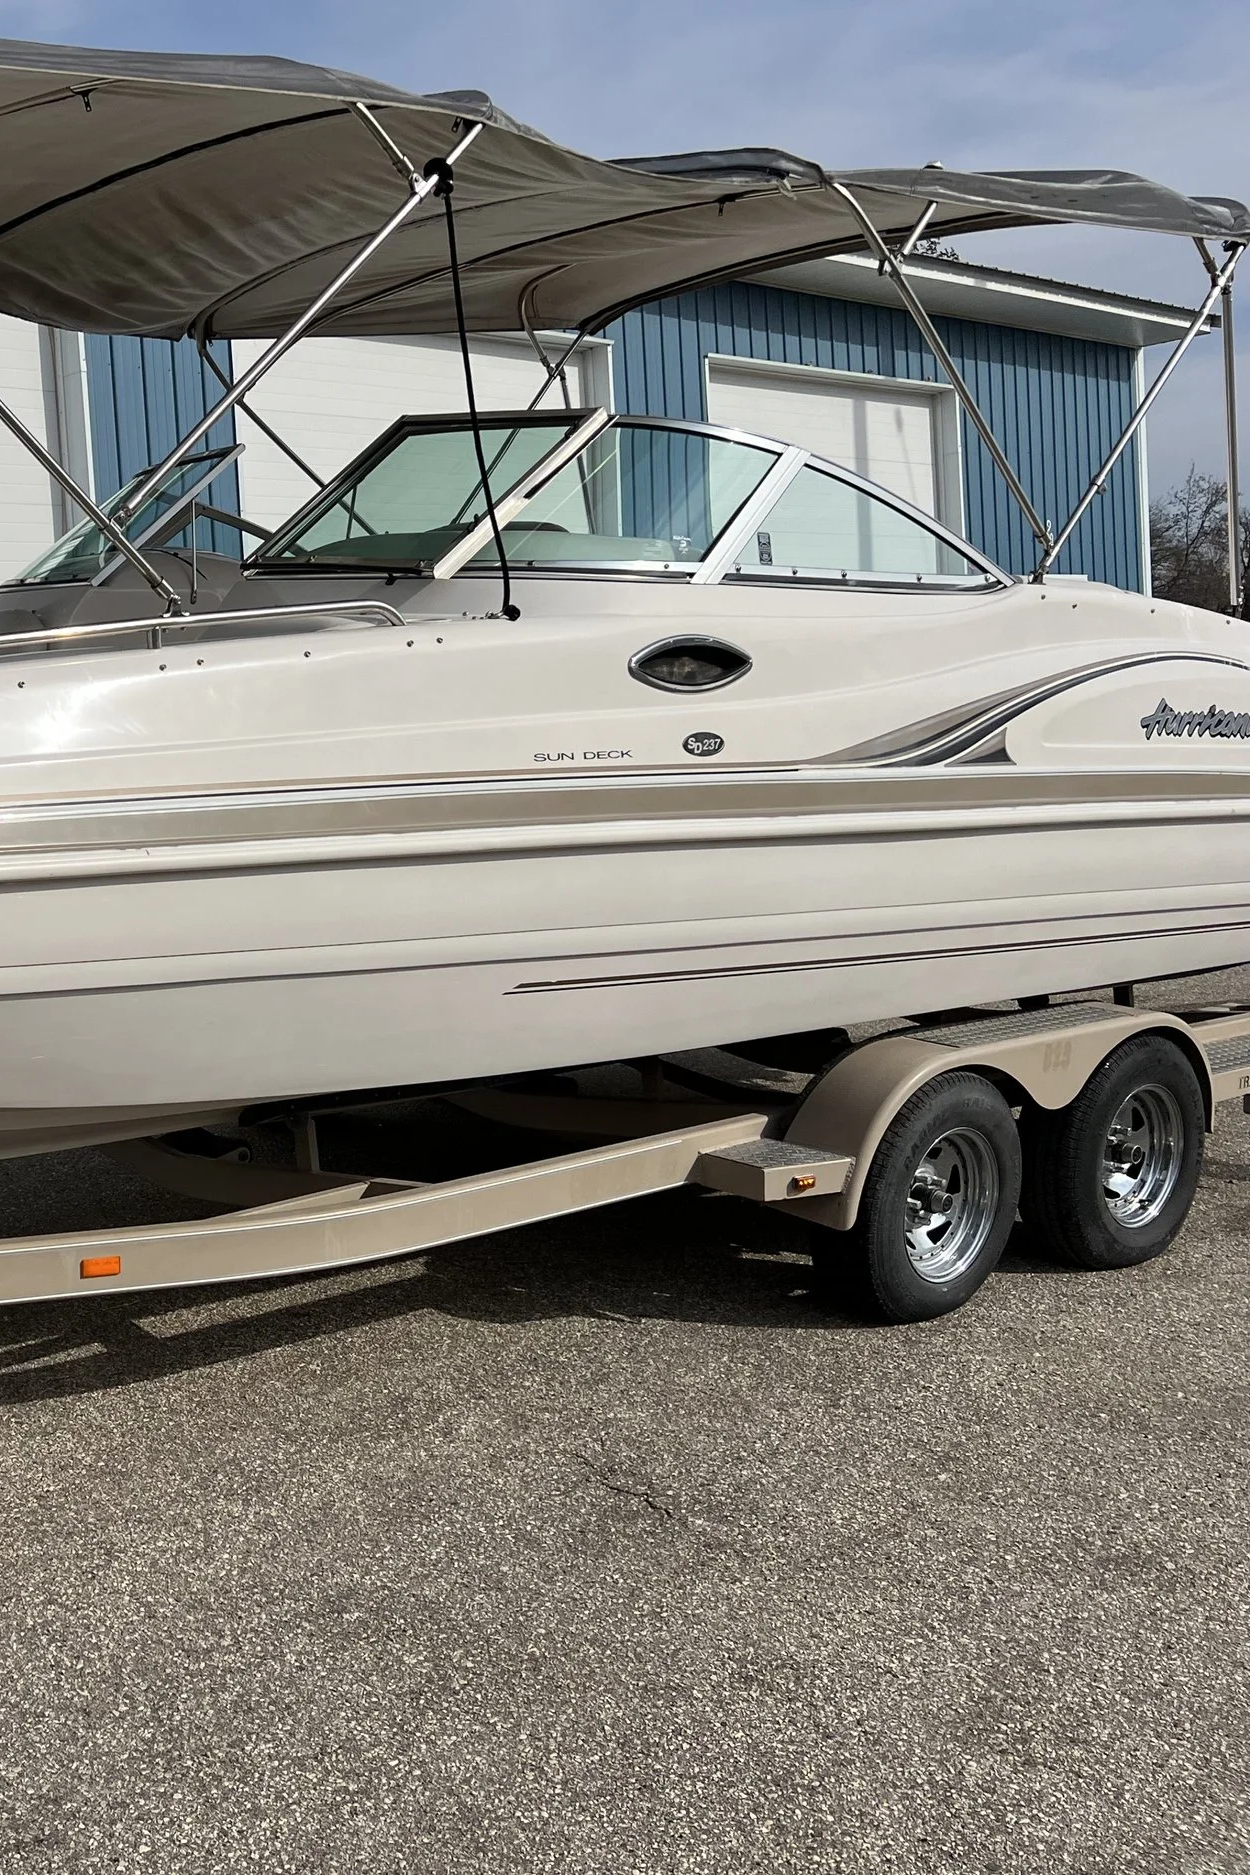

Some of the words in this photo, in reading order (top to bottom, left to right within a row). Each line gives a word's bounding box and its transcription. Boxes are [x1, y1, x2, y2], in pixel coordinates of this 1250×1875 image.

[1141, 697, 1250, 740] Hurrican
[534, 752, 575, 762] SUN
[583, 750, 633, 760] DECK
